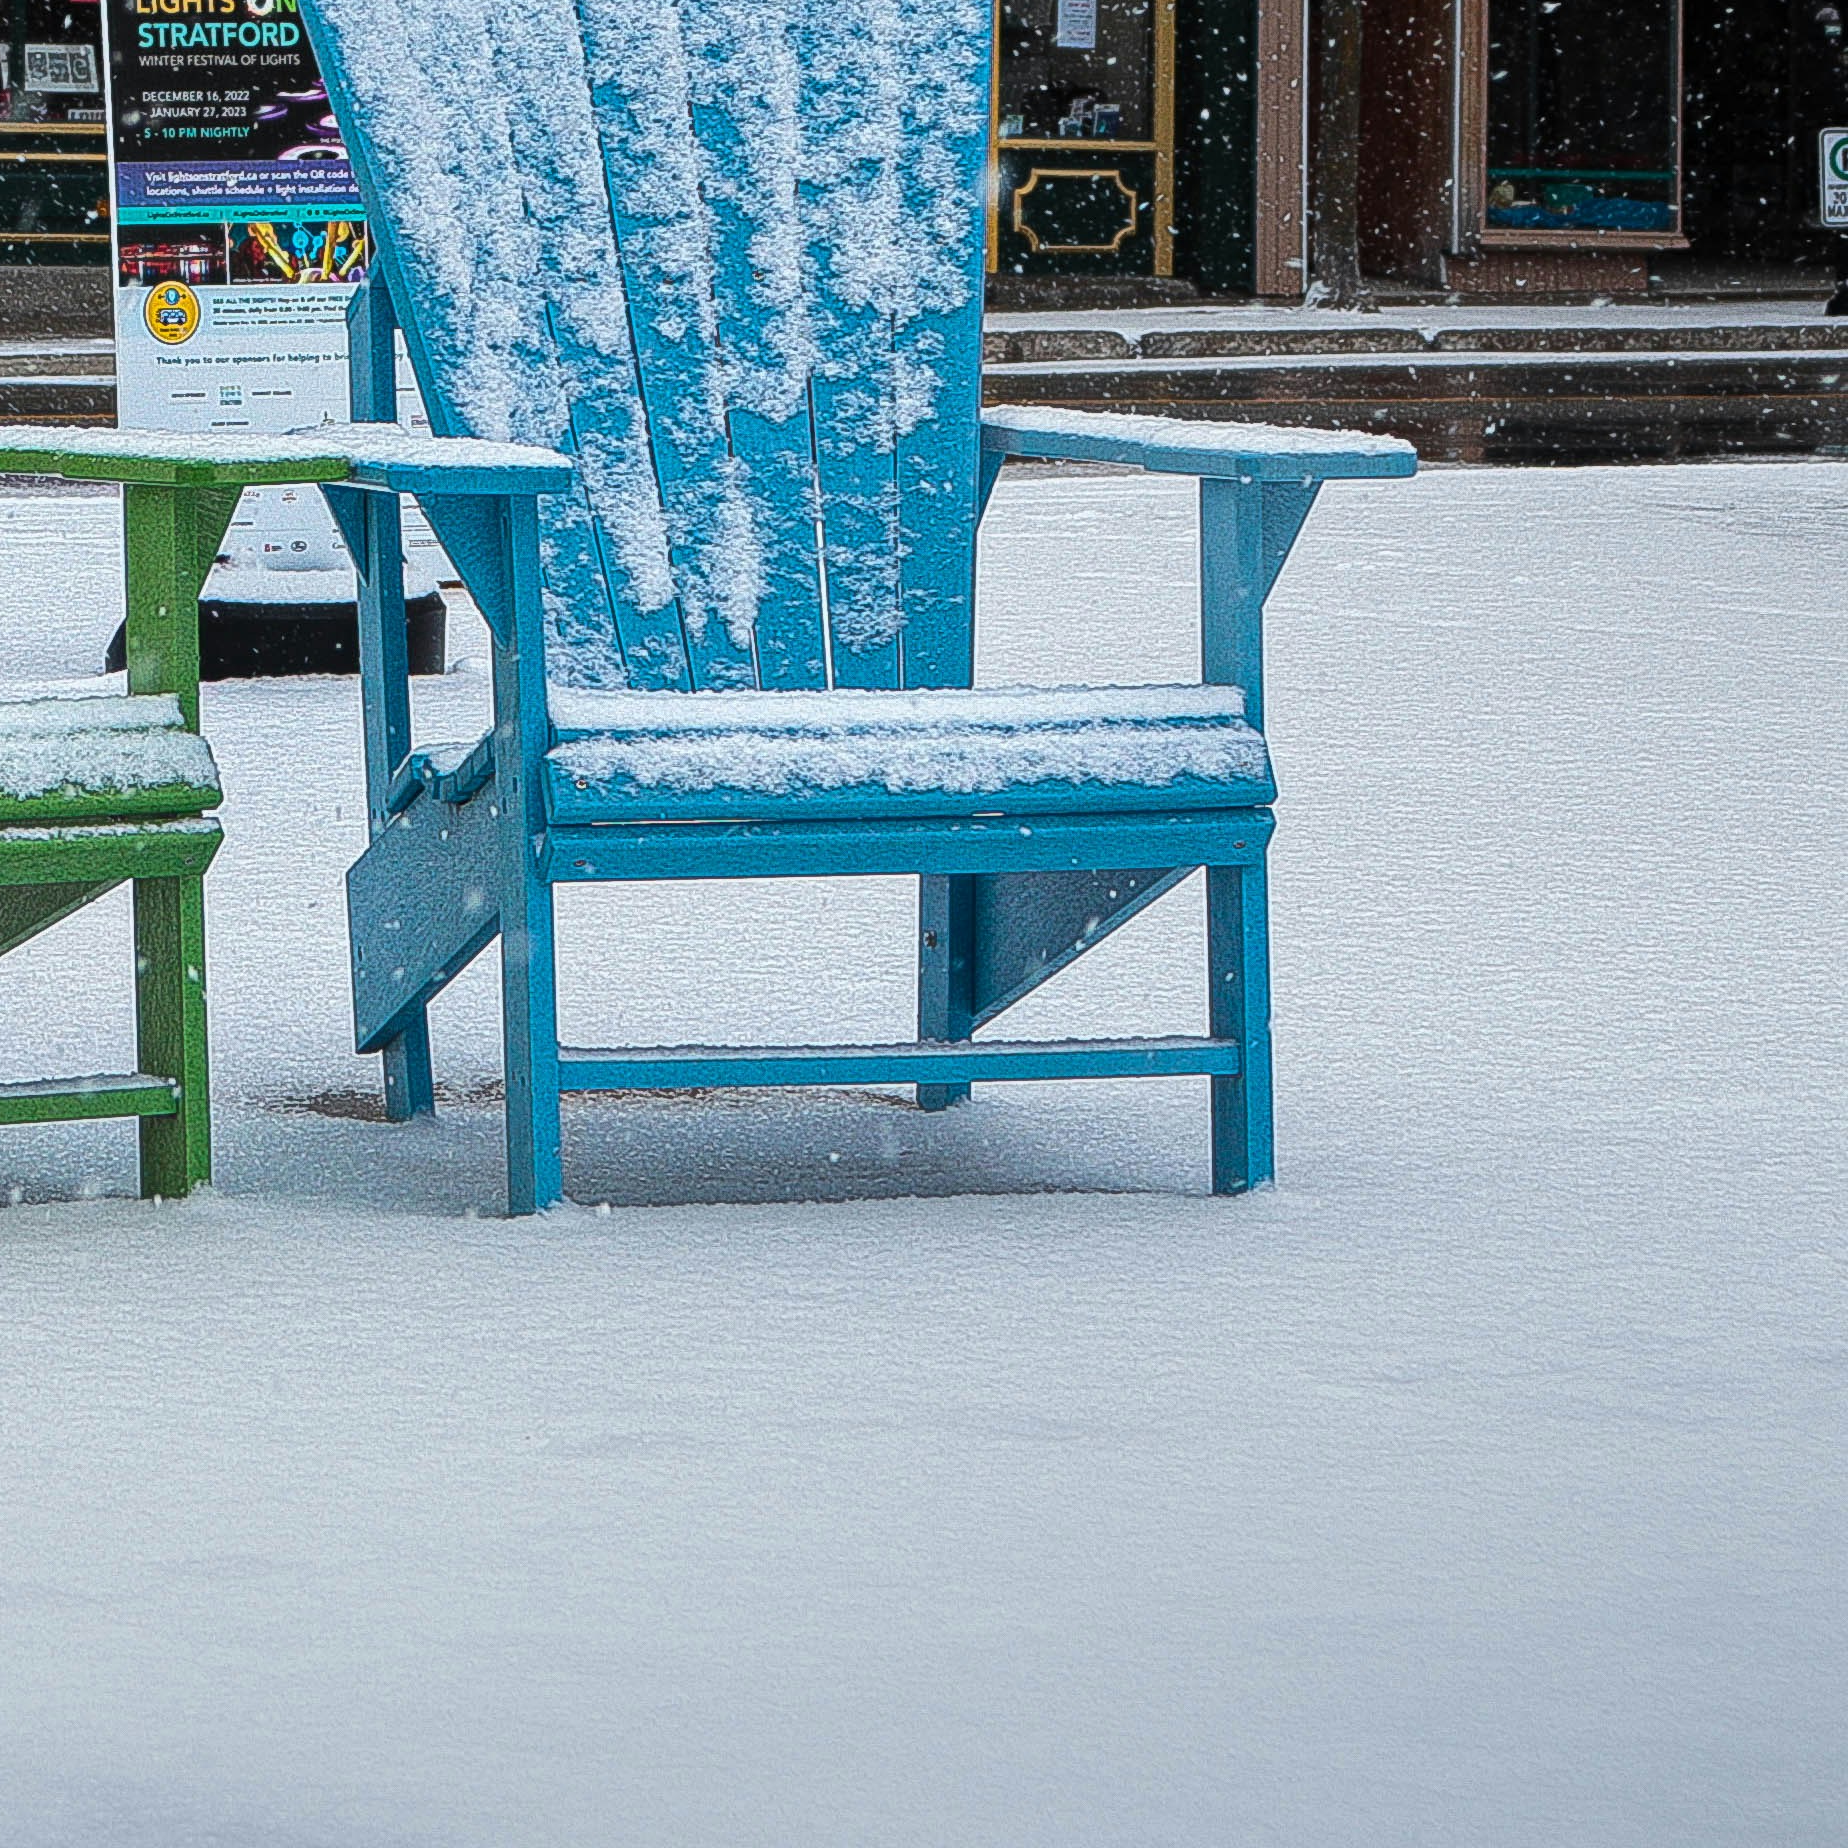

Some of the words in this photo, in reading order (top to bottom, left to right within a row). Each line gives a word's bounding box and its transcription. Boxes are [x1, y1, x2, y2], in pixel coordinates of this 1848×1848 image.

[137, 21, 300, 49] STRATFORD
[138, 54, 185, 67] WINTER
[187, 54, 238, 66] FESTIVAL
[240, 54, 257, 66] OF
[260, 53, 301, 66] LIGHTS
[142, 90, 204, 102] DECEMBER
[224, 90, 250, 101] 2022
[149, 107, 202, 119] JANUARY
[222, 107, 247, 118] 2023
[161, 127, 176, 138] 10
[178, 127, 197, 138] PM
[200, 126, 250, 139] NIGHTLY
[293, 169, 308, 180] the
[310, 169, 325, 180] QR
[327, 168, 349, 179] code
[156, 356, 182, 365] Thank
[184, 357, 201, 367] you
[202, 356, 212, 364] to
[232, 354, 271, 366] sponsors
[272, 353, 285, 363] for
[287, 353, 320, 364] helping
